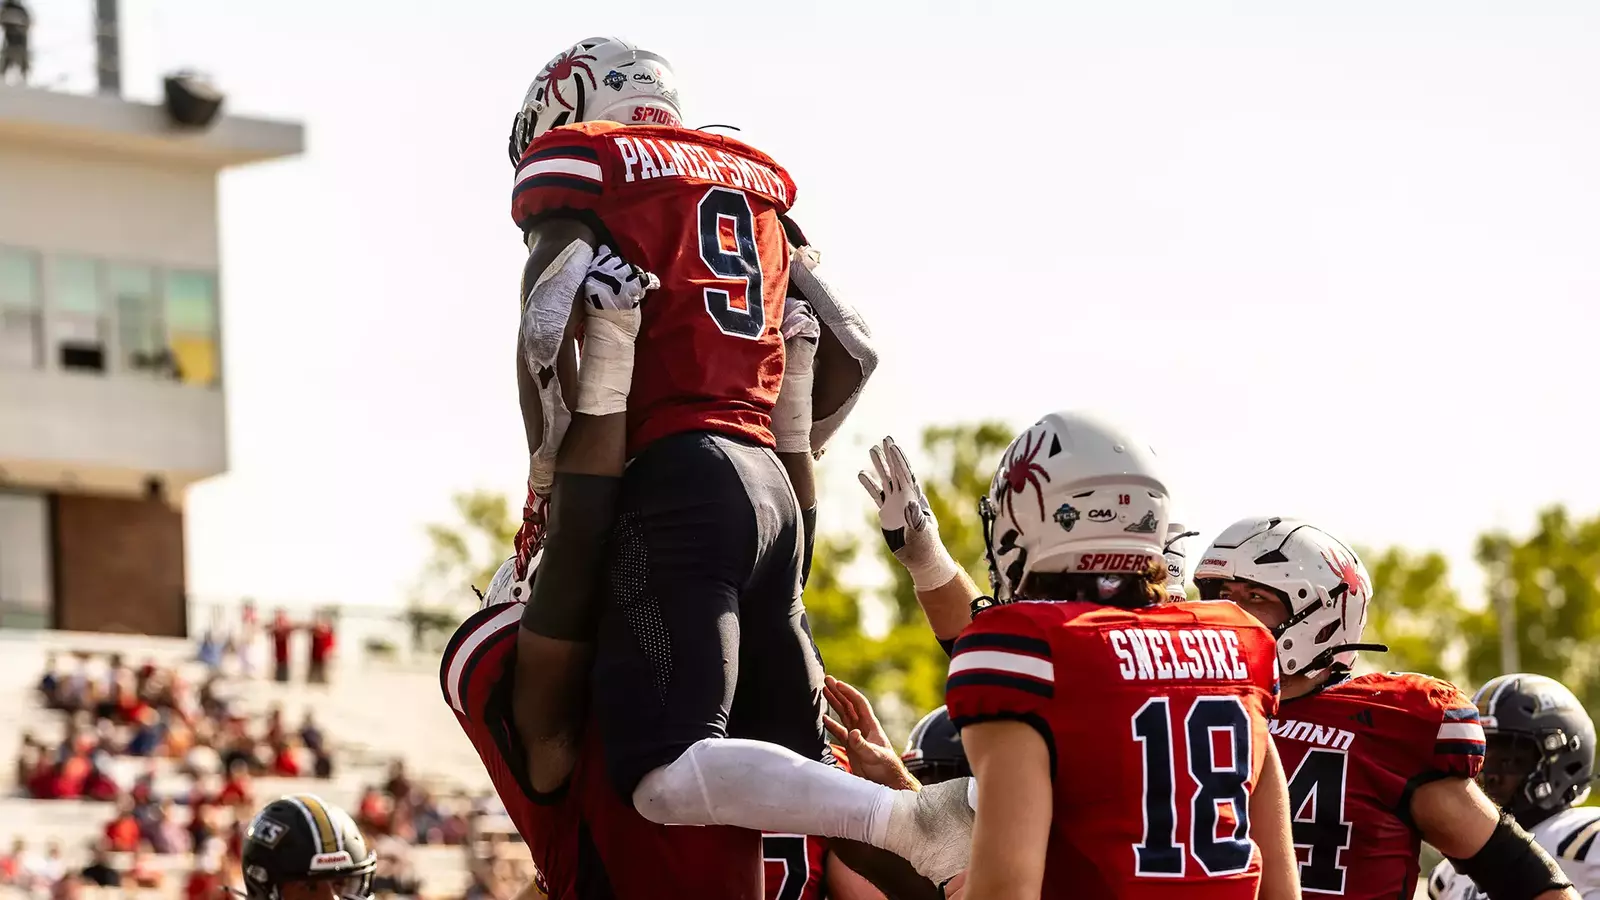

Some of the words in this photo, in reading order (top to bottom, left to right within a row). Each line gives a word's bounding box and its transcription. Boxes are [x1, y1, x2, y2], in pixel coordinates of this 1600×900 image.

[633, 73, 652, 81] CAA
[616, 137, 787, 202] PALMER-SMITH
[697, 186, 765, 340] 9
[1088, 509, 1112, 518] CAA
[1118, 494, 1130, 505] 18
[1077, 553, 1152, 571] SPIDERS
[1168, 564, 1180, 573] CAA
[1109, 629, 1247, 680] SNELSIRE
[1131, 696, 1253, 878] 18
[1287, 747, 1352, 895] 4
